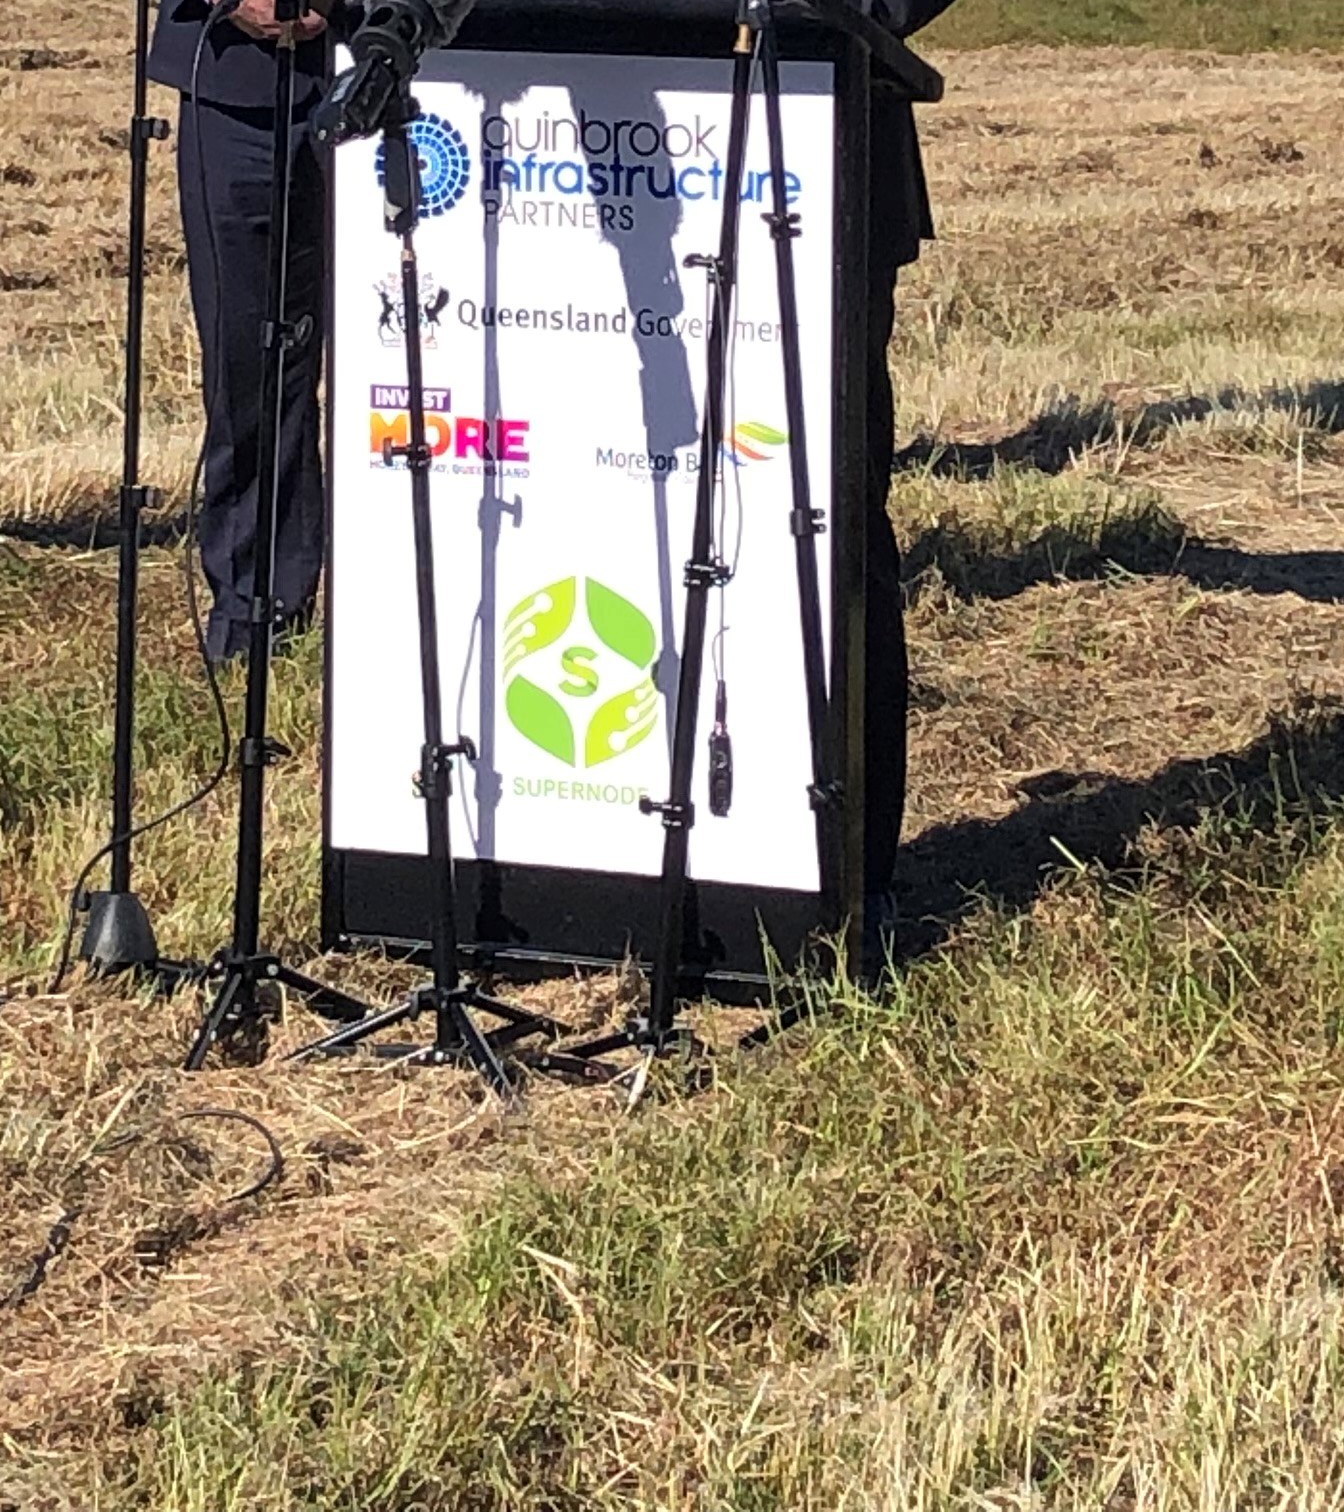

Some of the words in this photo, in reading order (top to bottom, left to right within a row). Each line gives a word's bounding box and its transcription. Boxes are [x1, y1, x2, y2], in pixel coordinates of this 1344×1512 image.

[482, 109, 718, 160] quinbrook
[484, 199, 634, 231] PARTNERS
[457, 299, 626, 334] Queensland
[636, 308, 799, 342] Goverme
[375, 387, 448, 409] INVST
[596, 447, 678, 471] Moreton
